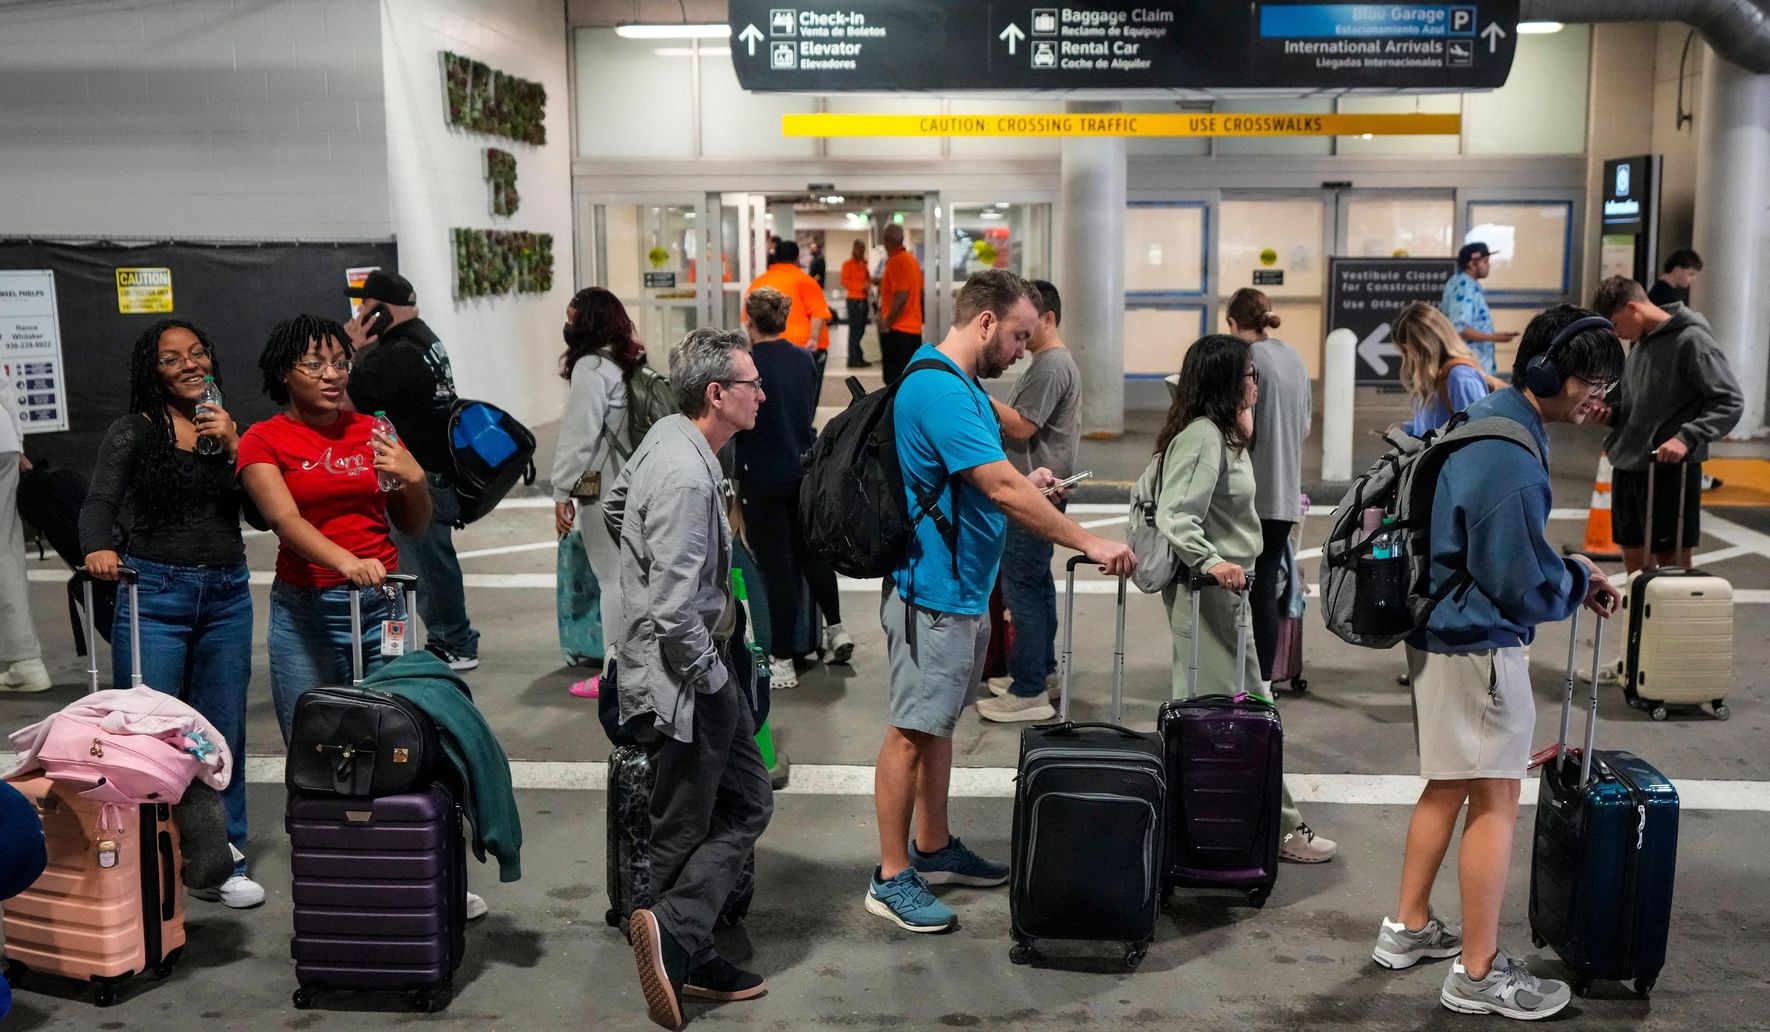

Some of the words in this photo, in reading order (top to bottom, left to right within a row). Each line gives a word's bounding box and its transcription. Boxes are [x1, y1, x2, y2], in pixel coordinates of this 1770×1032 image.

[1061, 8, 1127, 26] Baggage
[1132, 8, 1174, 22] Claim
[1352, 6, 1386, 20] Blue
[1391, 7, 1445, 24] Garage
[1454, 11, 1469, 30] P
[800, 26, 830, 37] Venta
[831, 26, 845, 37] de
[847, 26, 886, 37] Boletos
[1061, 26, 1105, 36] Reclamo
[1107, 26, 1121, 36] de
[1123, 26, 1167, 38] Equipaje
[1335, 24, 1420, 34] Estacionamiento
[1422, 24, 1445, 34] Azul
[800, 40, 862, 56] Elevator
[1061, 40, 1109, 55] Rental
[1113, 40, 1140, 55] Car
[1284, 40, 1381, 54] International
[1385, 40, 1443, 54] Arrivals
[800, 58, 856, 70] Elevadores
[1061, 58, 1094, 69] Coche
[1095, 58, 1109, 69] de
[1111, 58, 1152, 71] Alquiler
[1316, 57, 1362, 70] Llegadas
[1364, 57, 1443, 67] Internacionales
[998, 117, 1072, 132] CROSSING
[1080, 117, 1138, 132] TRAFFIC
[1189, 117, 1216, 132] USE
[1223, 117, 1322, 132] CROSSWALKS
[119, 272, 168, 286] CAUTION
[1341, 270, 1400, 280] Vestibule
[1405, 270, 1447, 280] Closed
[1342, 282, 1360, 292] for
[1343, 299, 1365, 309] Use
[1371, 299, 1405, 309] Other
[302, 447, 368, 474] Aero
